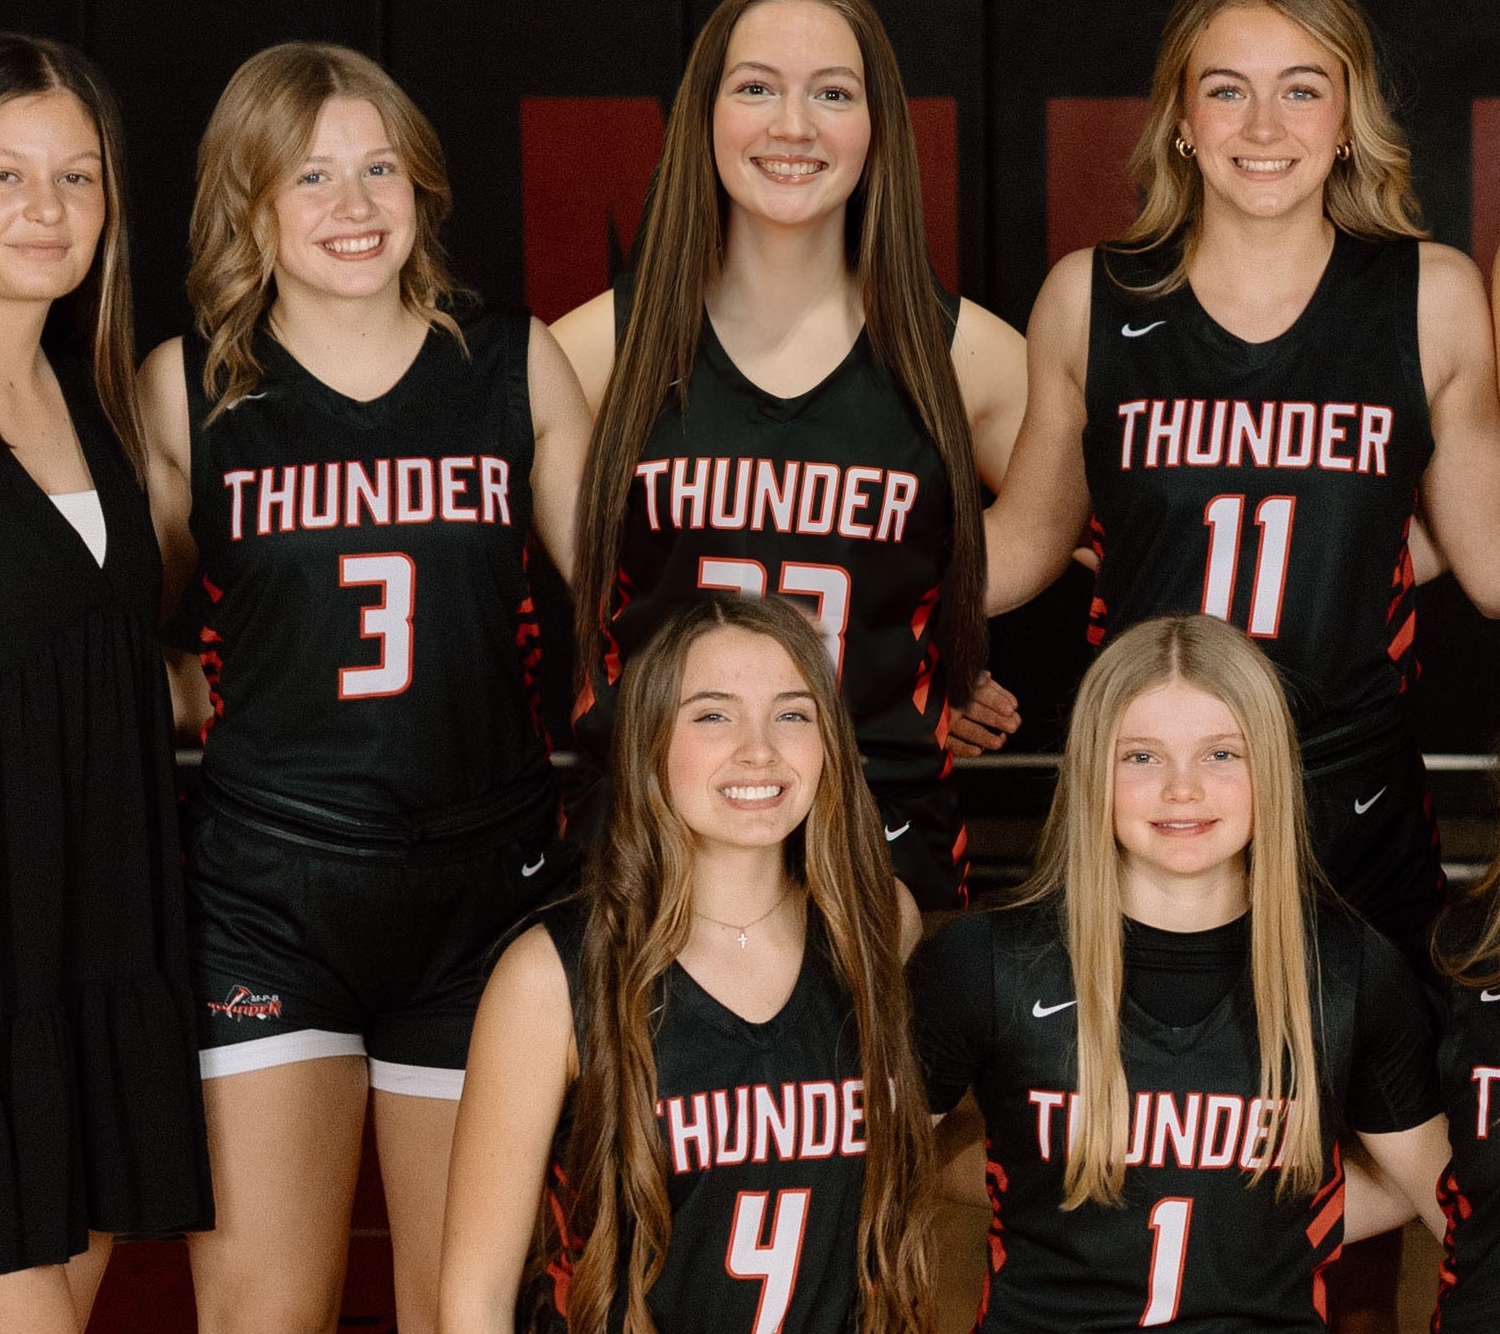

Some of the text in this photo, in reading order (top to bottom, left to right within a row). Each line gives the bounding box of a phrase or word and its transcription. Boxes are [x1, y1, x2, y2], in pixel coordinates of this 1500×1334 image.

[1117, 398, 1394, 476] THUNDER
[222, 454, 513, 541] THUNDER
[634, 456, 920, 544] THUNDER
[1202, 493, 1298, 639] 11
[337, 551, 418, 701] 3
[655, 1077, 898, 1175] HUNDE
[1138, 1196, 1195, 1329] 1
